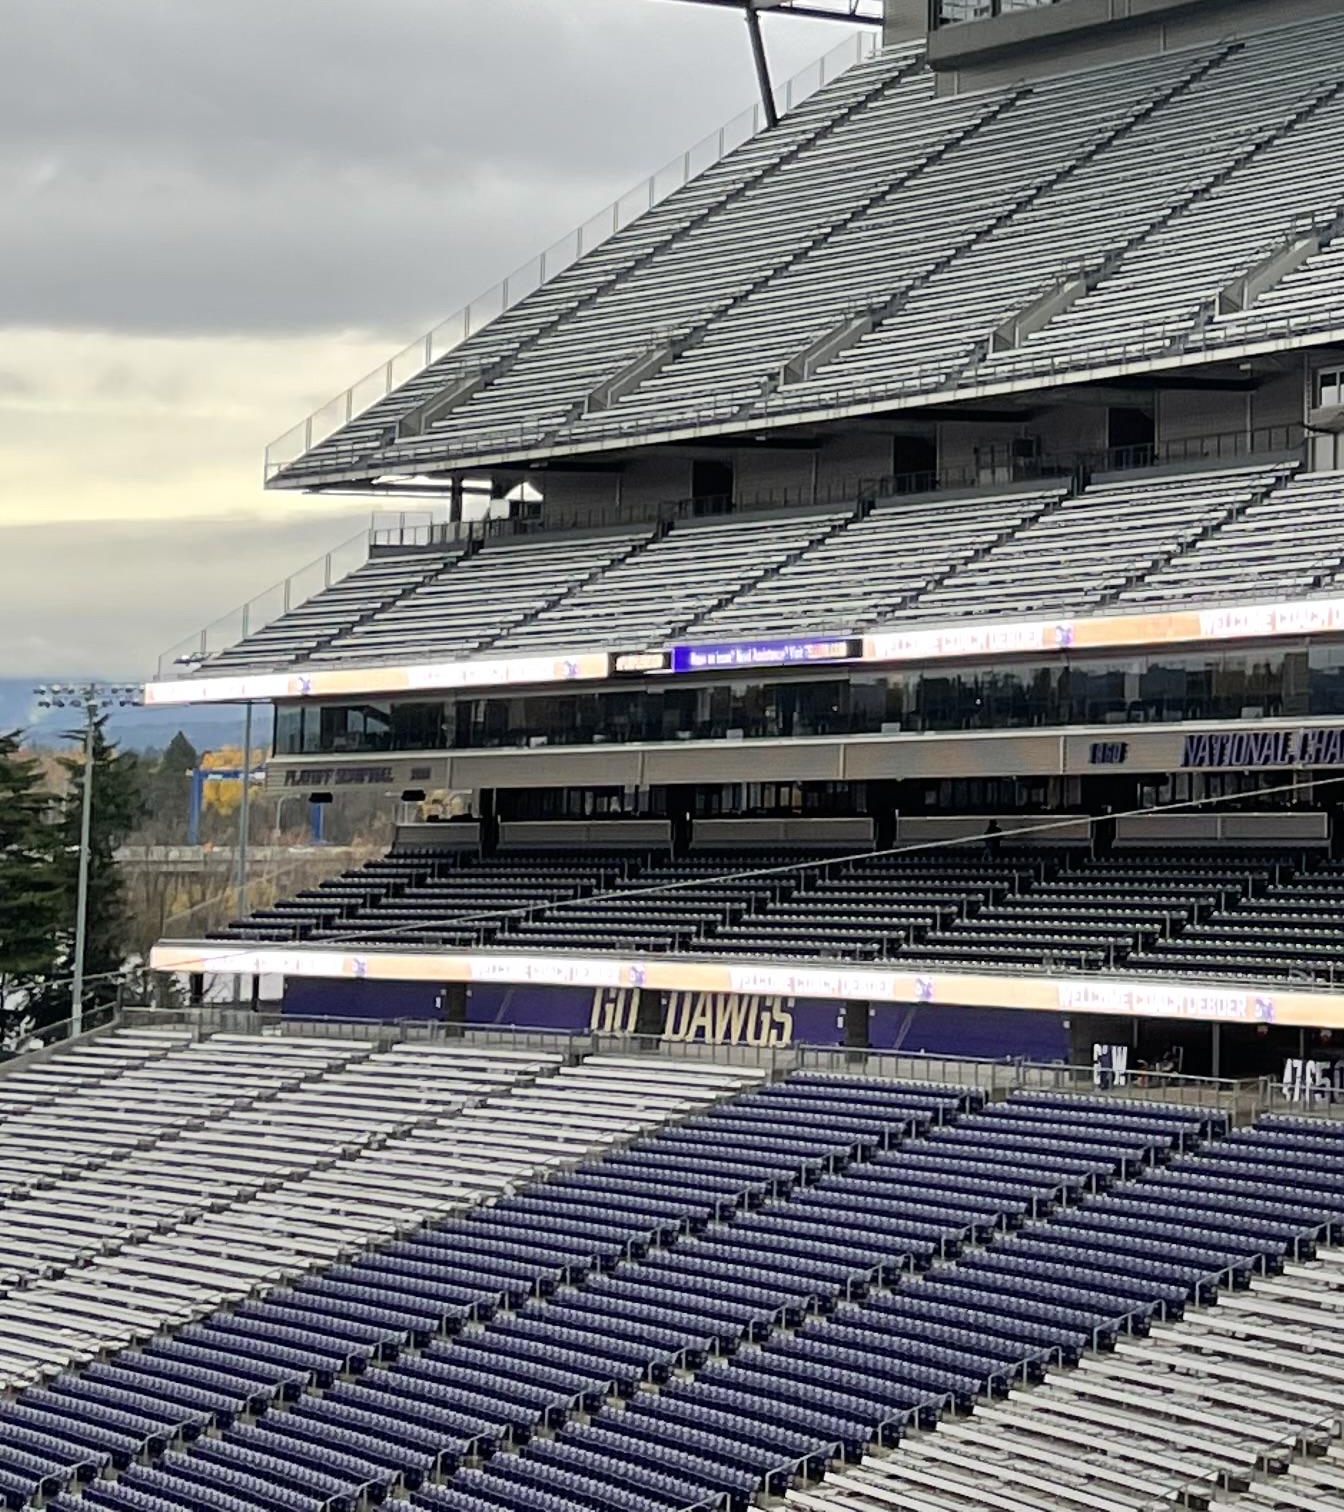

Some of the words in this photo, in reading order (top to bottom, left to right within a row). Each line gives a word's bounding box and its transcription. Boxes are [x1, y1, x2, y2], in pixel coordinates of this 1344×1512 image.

[1182, 732, 1295, 767] NATIONAL
[590, 987, 640, 1034] GO
[660, 991, 795, 1048] DAWGS
